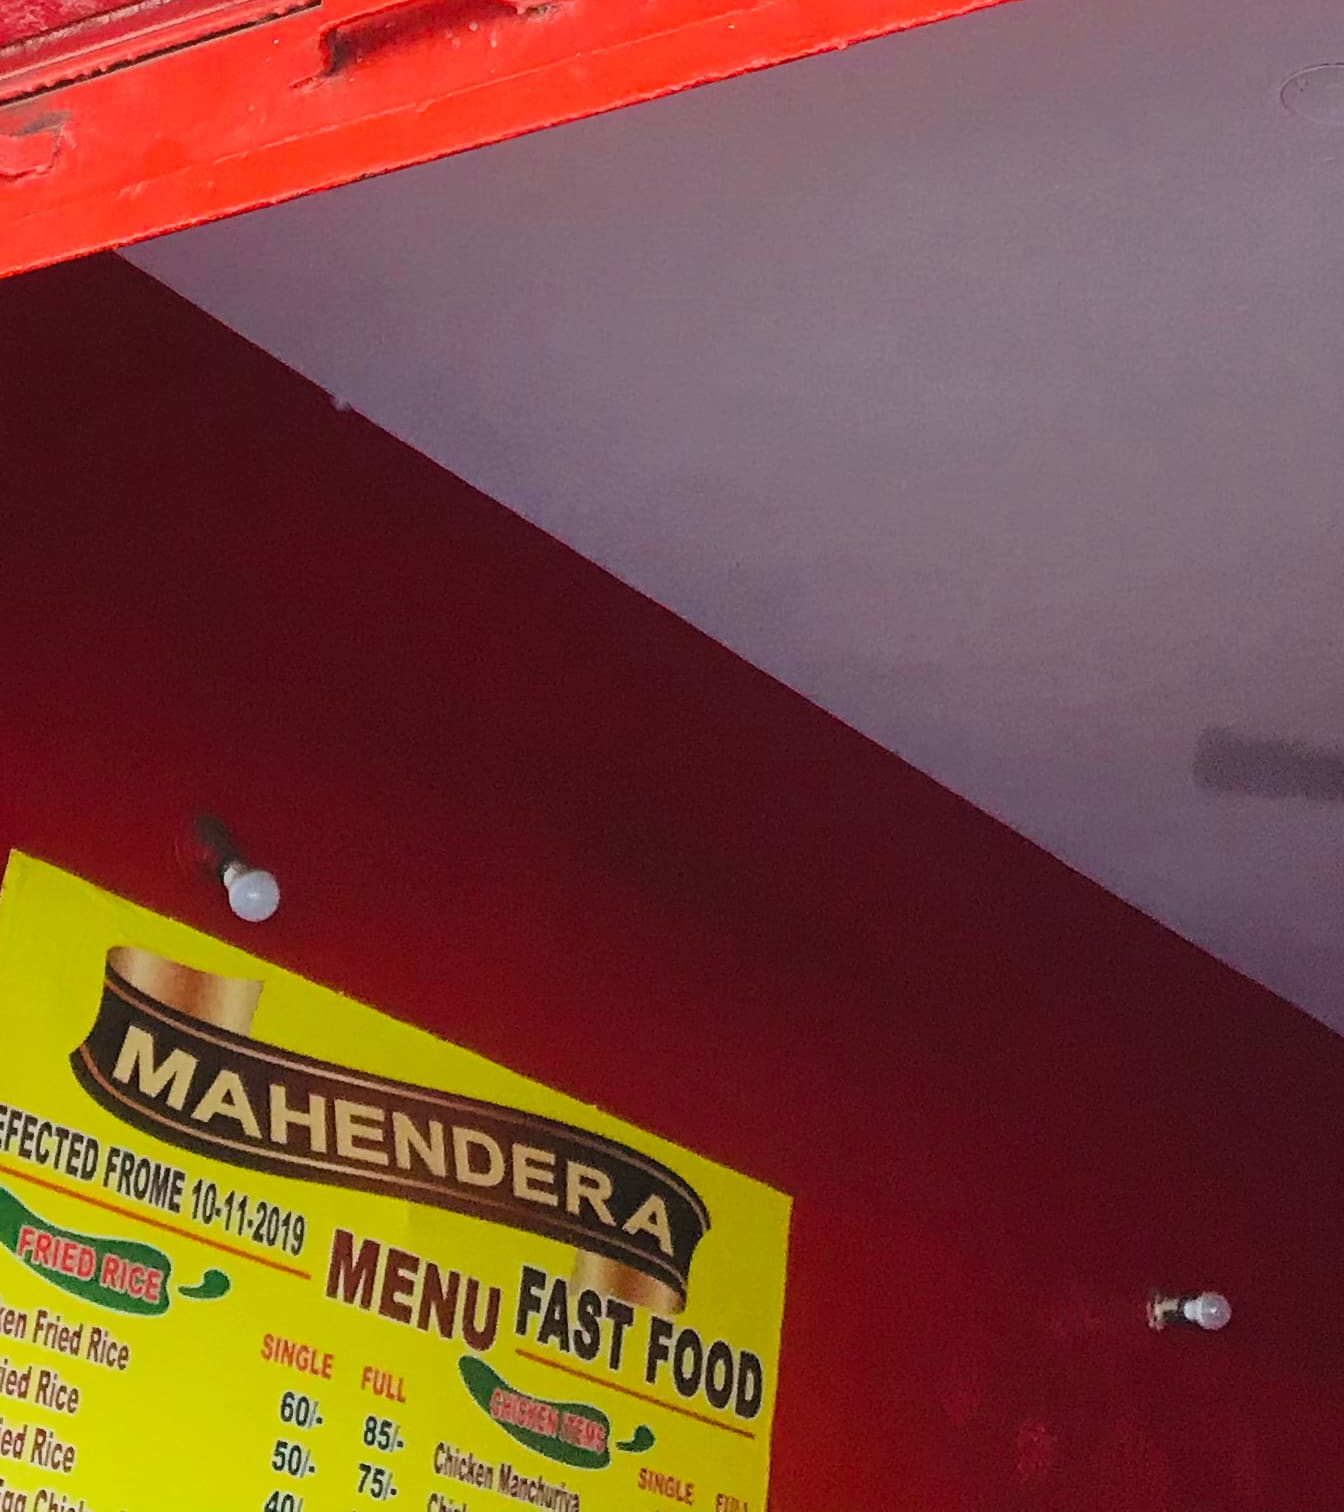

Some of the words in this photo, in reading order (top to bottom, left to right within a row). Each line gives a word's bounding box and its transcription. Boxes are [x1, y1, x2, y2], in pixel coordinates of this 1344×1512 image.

[113, 1025, 675, 1256] MAHENDERA
[103, 1146, 187, 1213] FROME
[192, 1178, 306, 1256] 10-11-2019
[17, 1226, 96, 1281] FRIED
[100, 1253, 163, 1303] RICE
[325, 1228, 501, 1351] MENU
[33, 1309, 84, 1357] Fried
[86, 1326, 130, 1371] Rice
[260, 1333, 334, 1379] SINGLE
[361, 1366, 406, 1403] FULL
[515, 1265, 634, 1370] FAST
[645, 1314, 763, 1418] FOOD
[35, 1369, 80, 1414] Rice
[280, 1391, 323, 1429] 60/-
[363, 1415, 404, 1452] 85/-
[31, 1428, 76, 1473] Rice
[272, 1440, 316, 1478] 50/-
[357, 1463, 398, 1500] 75/-
[434, 1443, 493, 1490] Chicken
[638, 1467, 694, 1506] SINGLE
